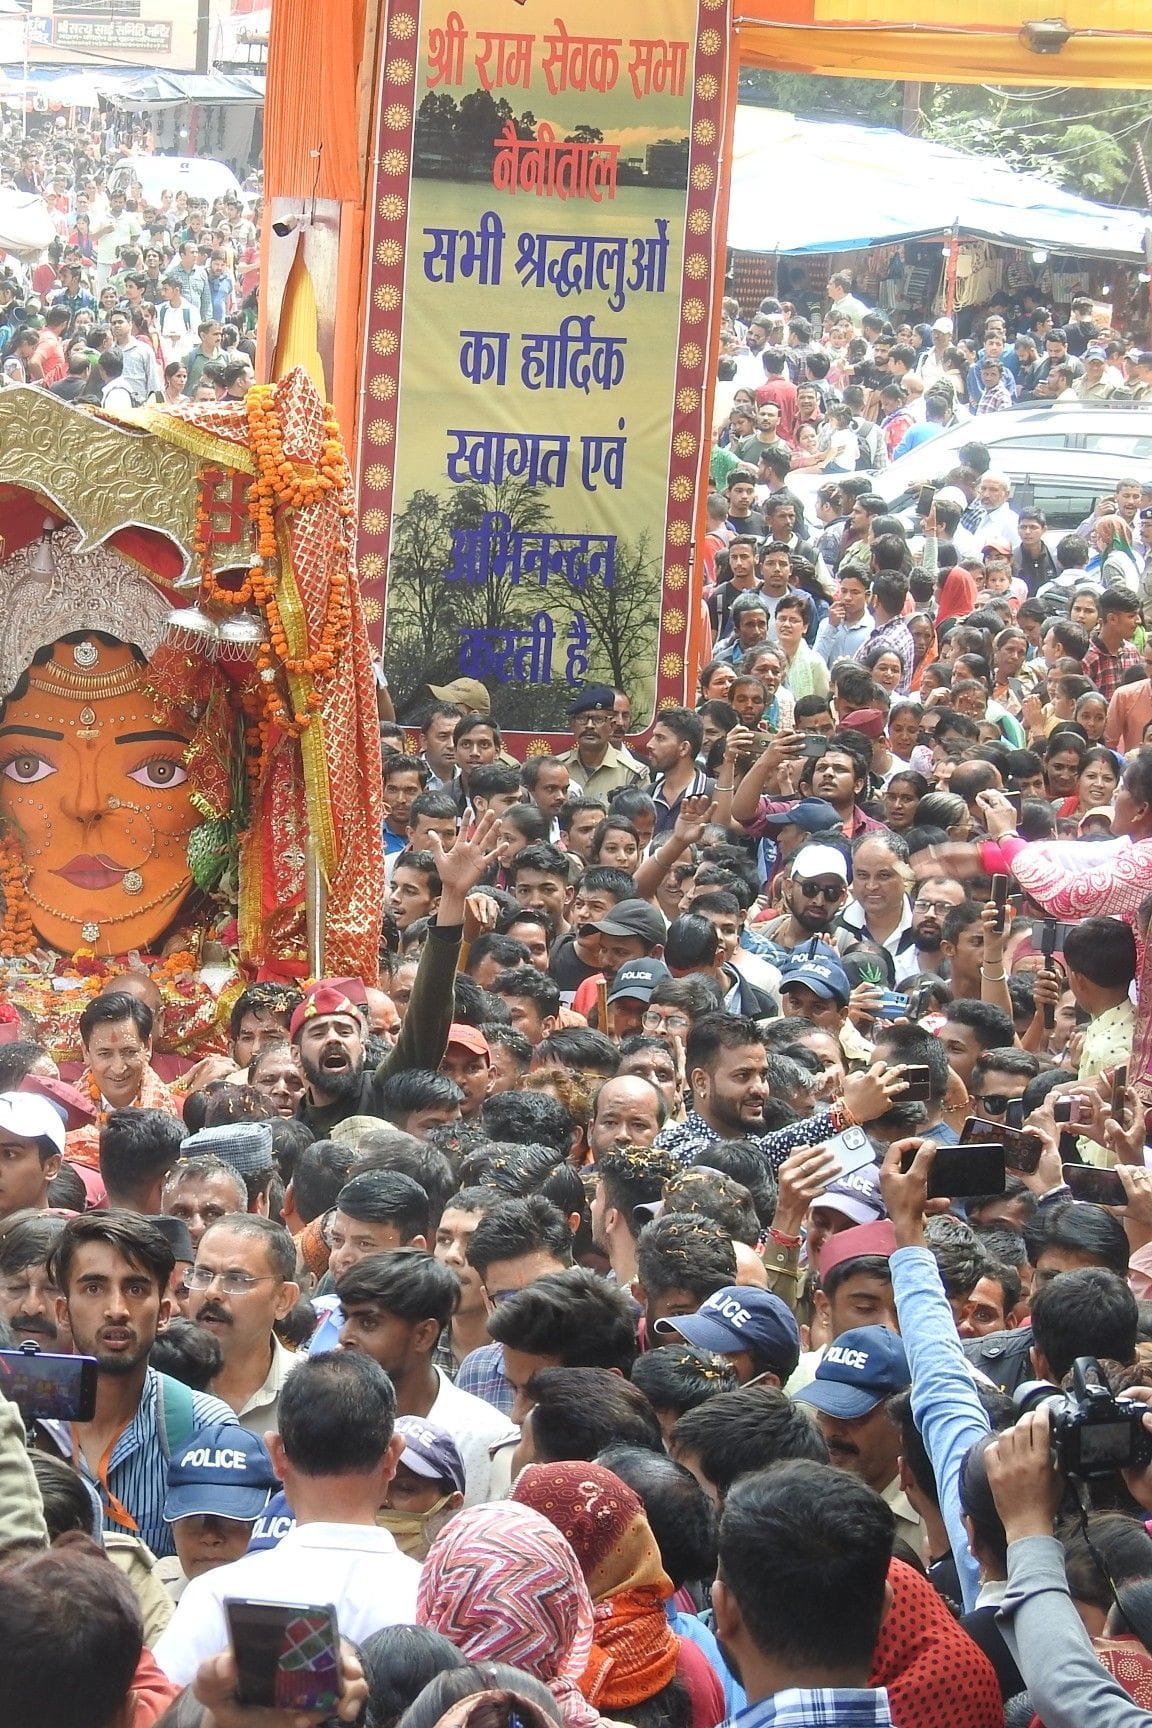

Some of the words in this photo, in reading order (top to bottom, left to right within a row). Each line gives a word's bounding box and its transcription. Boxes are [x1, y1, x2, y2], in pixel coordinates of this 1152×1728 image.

[426, 10, 468, 89] श्री
[475, 31, 535, 91] राम
[542, 18, 622, 96] सेवक
[628, 39, 689, 100] सभा
[492, 119, 620, 202] नैनीताल
[423, 211, 506, 285] सभी
[514, 218, 670, 312] श्रद्धालुओं
[459, 330, 511, 386] का
[520, 314, 627, 395] हार्दिक
[447, 429, 570, 489] स्वागत
[580, 416, 627, 492] एवं
[444, 511, 617, 591] अभिनन्दन
[457, 610, 556, 686] करती
[565, 610, 591, 688] है
[621, 971, 652, 981] POLICE
[837, 1173, 875, 1197] LICE
[823, 1346, 870, 1370] POLICE
[181, 1448, 246, 1470] POLICE
